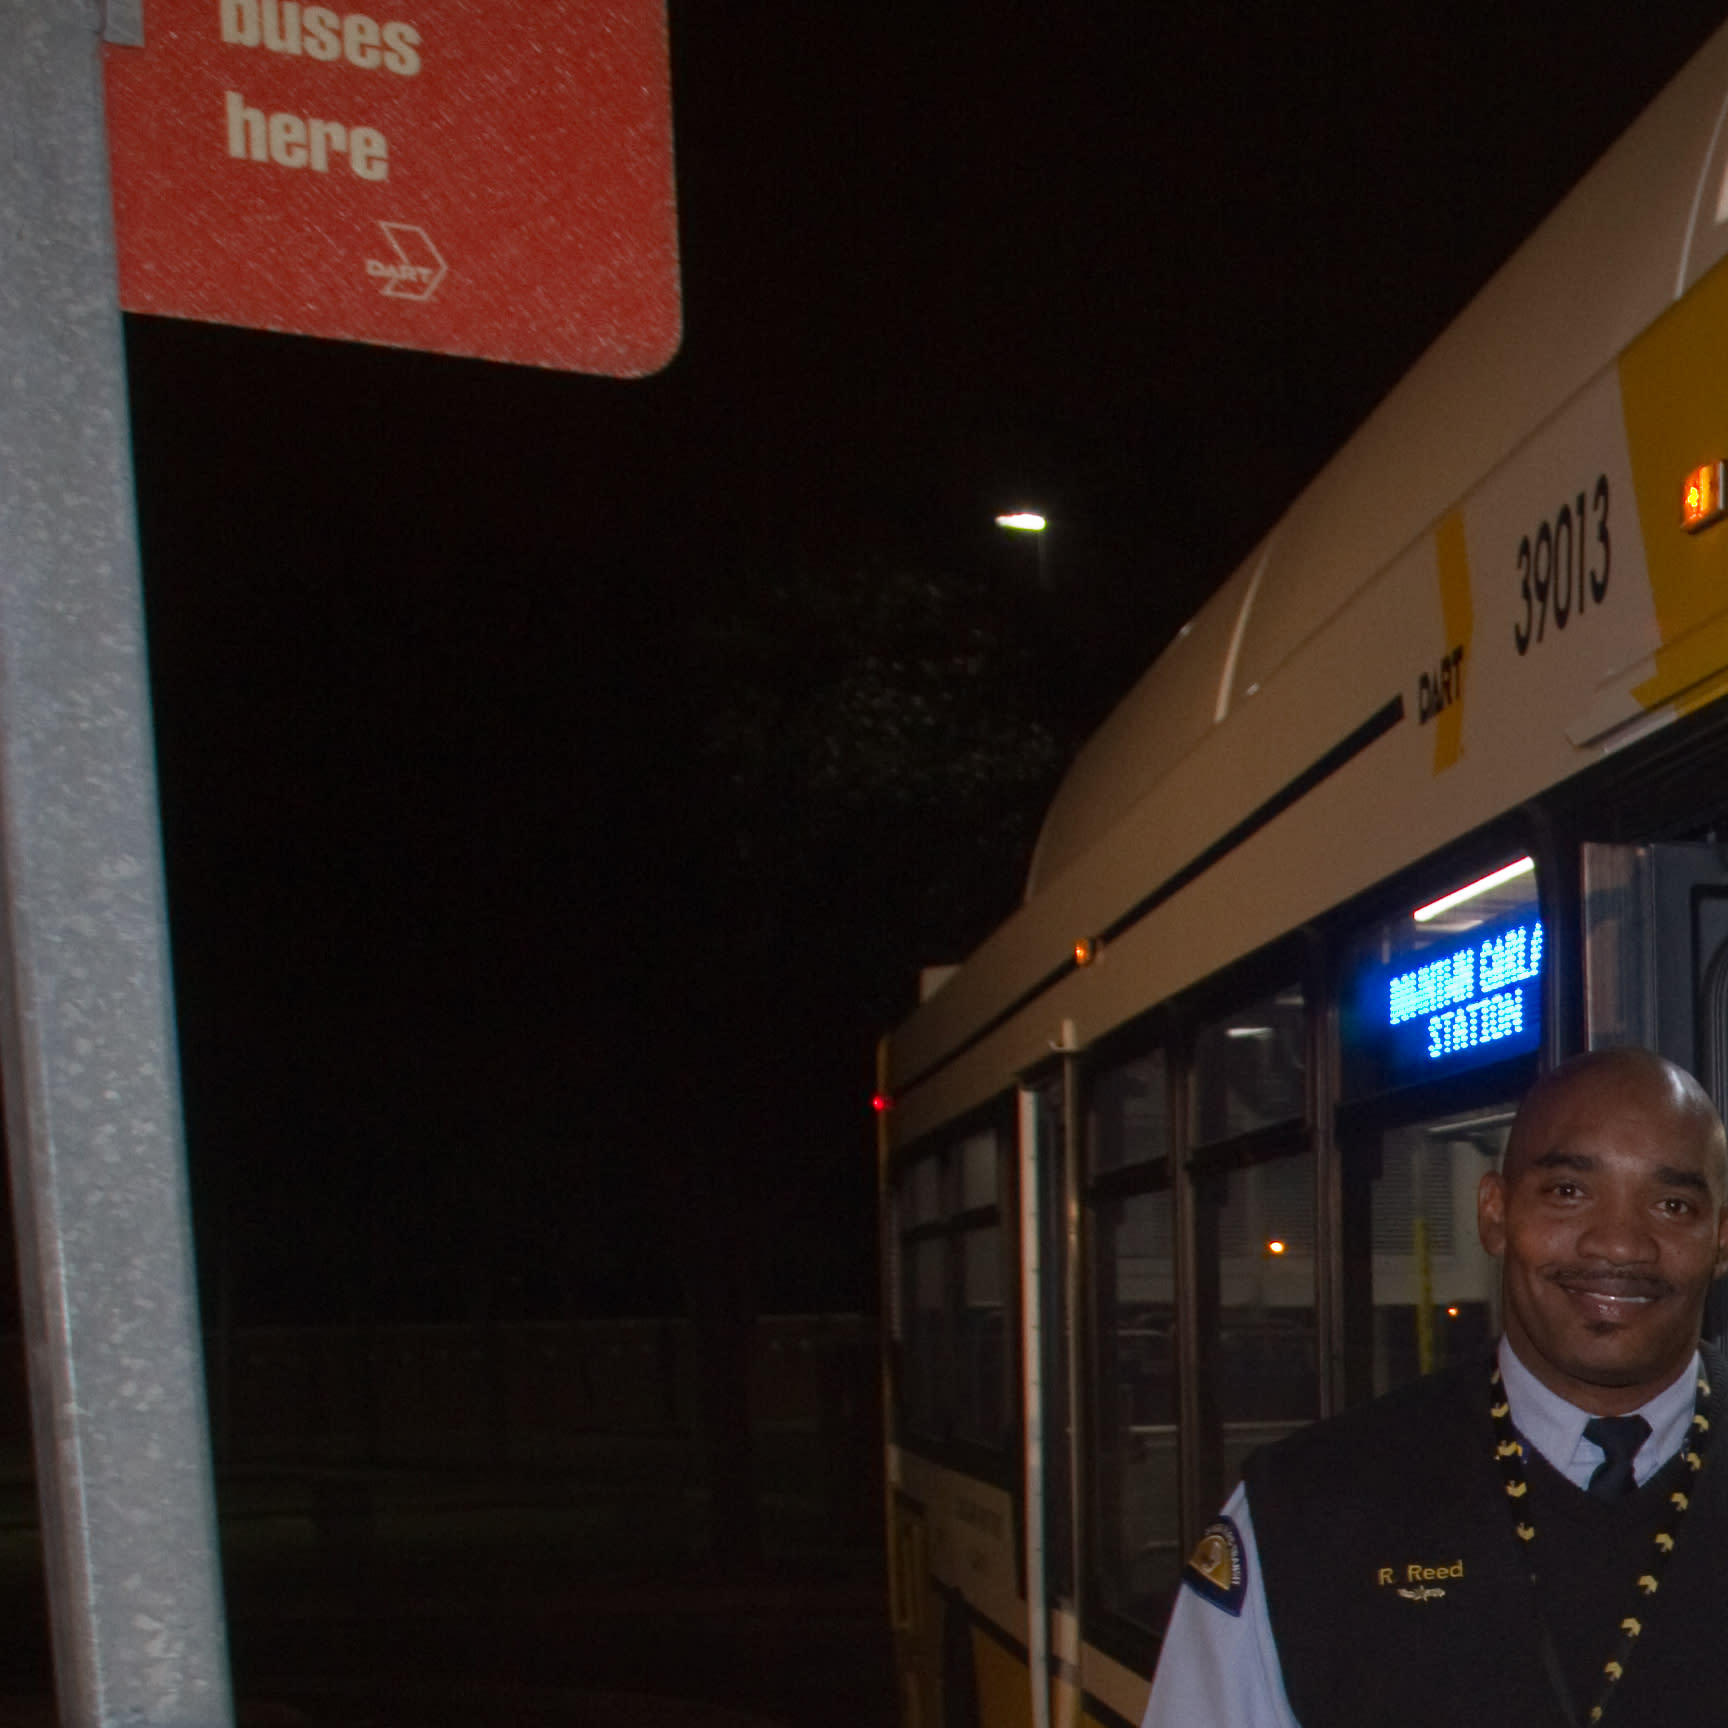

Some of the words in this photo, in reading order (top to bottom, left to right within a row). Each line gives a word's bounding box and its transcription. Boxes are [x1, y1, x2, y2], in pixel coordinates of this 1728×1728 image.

[220, 0, 423, 77] buses
[226, 90, 389, 182] here
[1514, 474, 1610, 656] 39013
[1419, 645, 1463, 726] DART
[1428, 988, 1523, 1058] STATION
[1379, 1567, 1394, 1586] R
[1407, 1559, 1464, 1582] Reed
